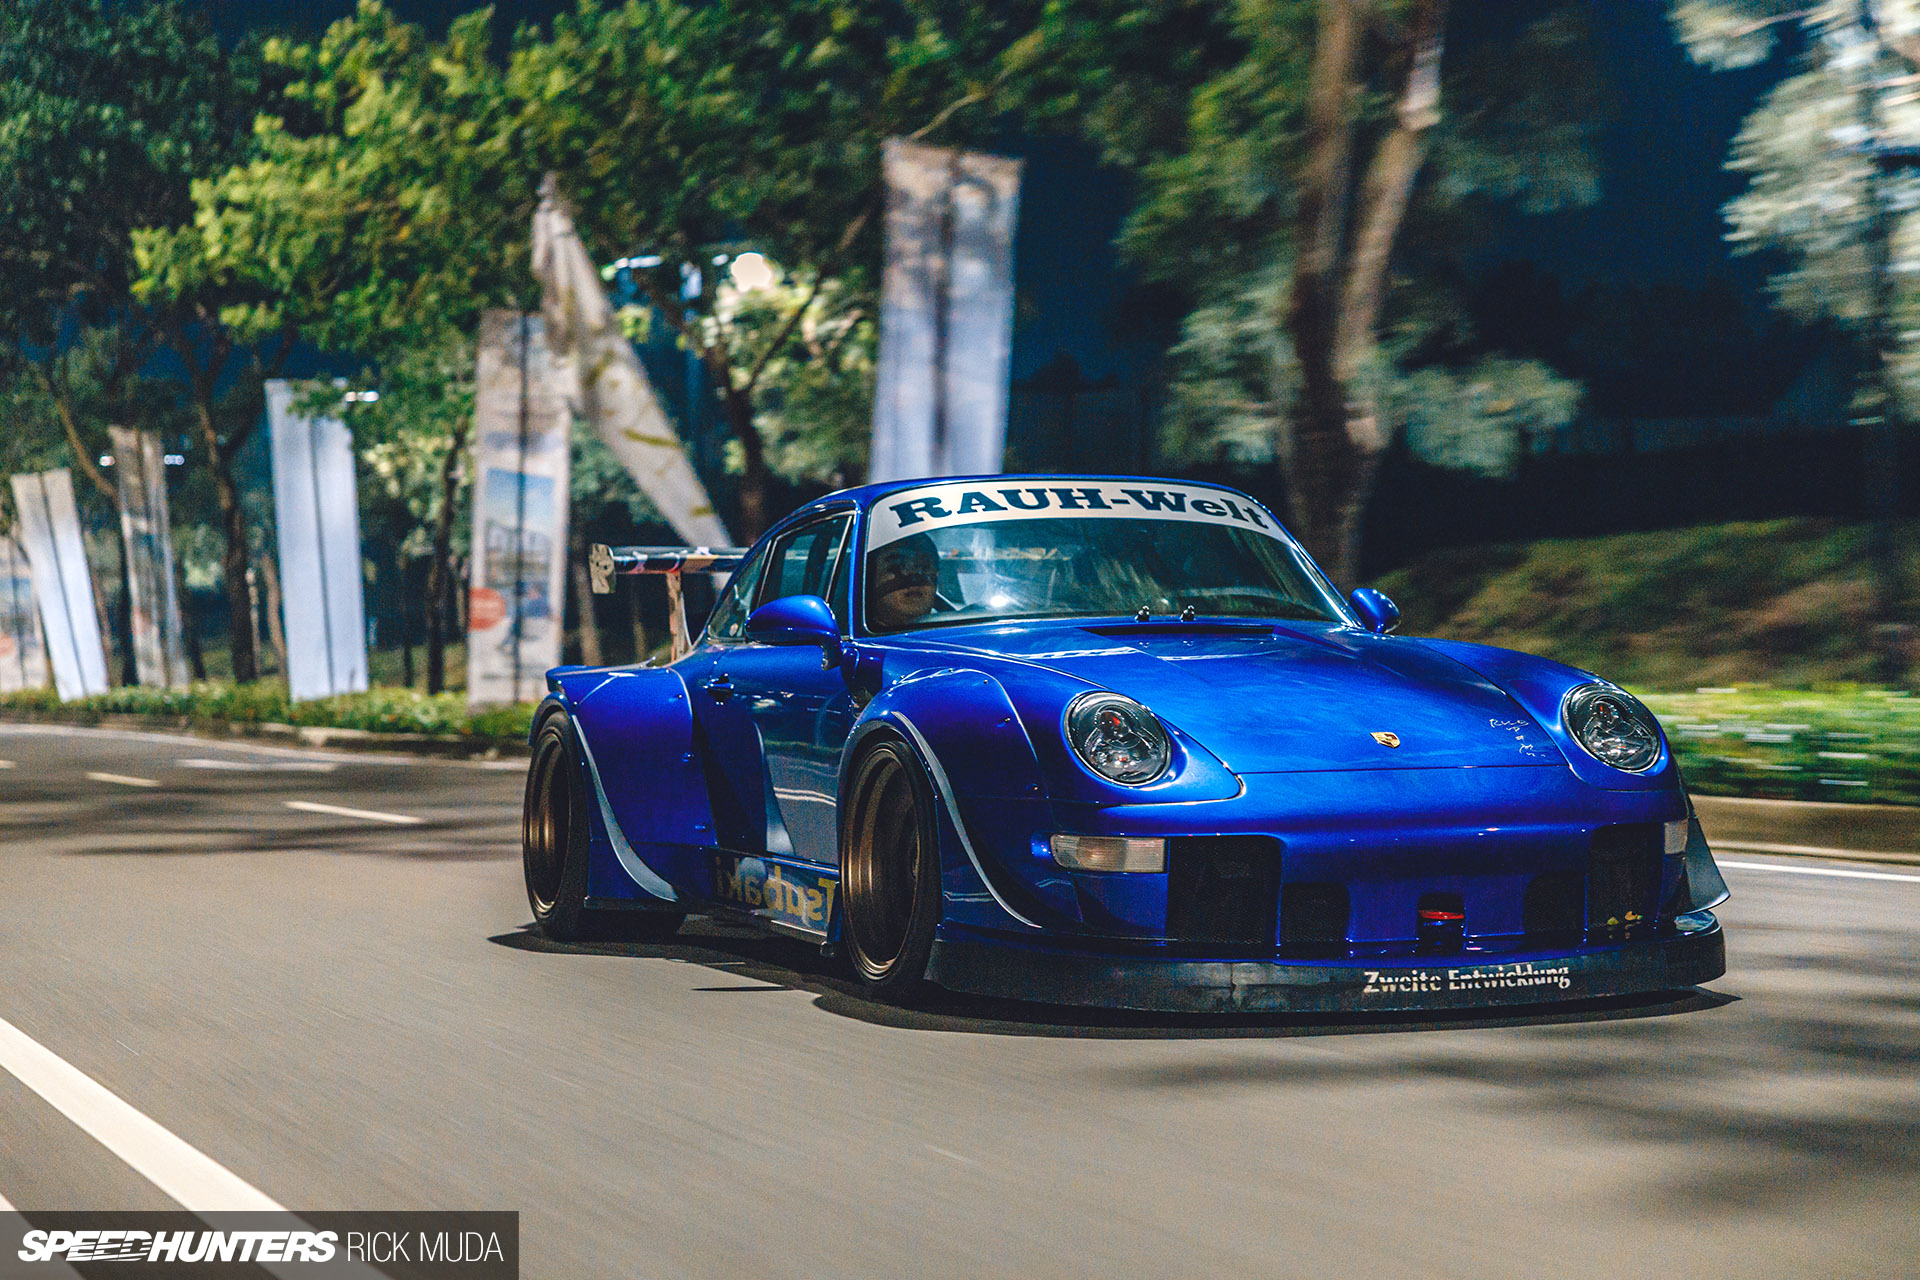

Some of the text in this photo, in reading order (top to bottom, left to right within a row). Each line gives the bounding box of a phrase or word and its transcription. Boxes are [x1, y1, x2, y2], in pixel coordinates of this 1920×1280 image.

[888, 488, 1269, 530] RAUH-Welt
[1363, 963, 1571, 993] Zweite Entwicklung
